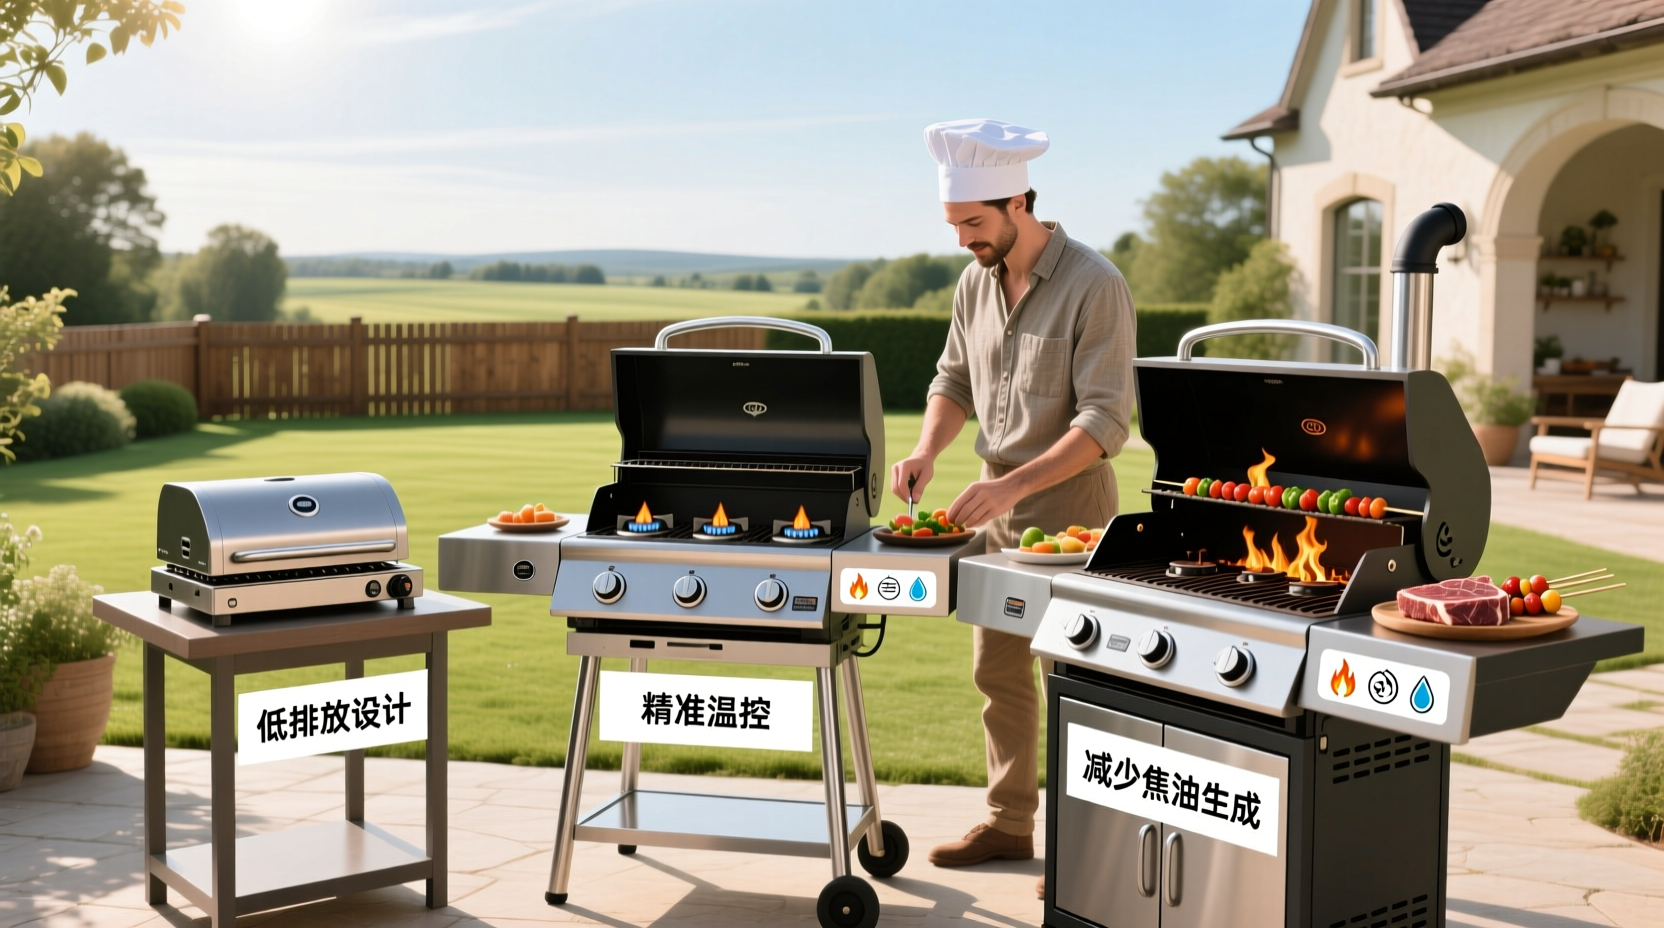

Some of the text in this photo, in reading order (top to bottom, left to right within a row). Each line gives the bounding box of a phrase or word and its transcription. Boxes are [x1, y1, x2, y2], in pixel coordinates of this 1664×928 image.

[257, 692, 411, 743] 低排放设计
[641, 692, 771, 730] 精准温控
[1083, 750, 1261, 829] 减少焦油生成
